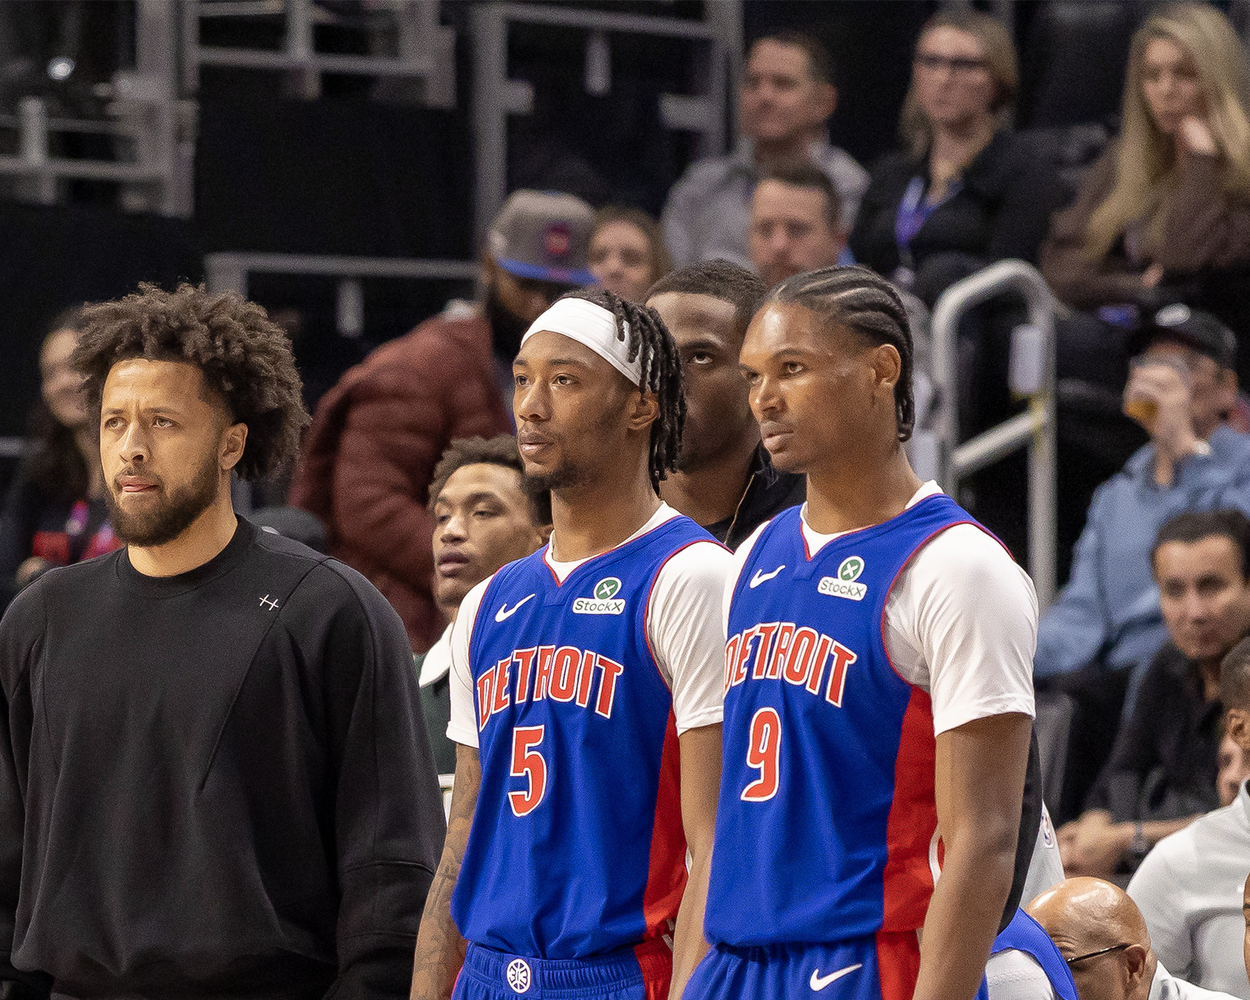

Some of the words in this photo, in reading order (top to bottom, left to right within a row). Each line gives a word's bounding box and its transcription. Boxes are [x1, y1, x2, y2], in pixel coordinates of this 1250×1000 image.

[575, 600, 622, 613] StockX
[821, 579, 865, 598] StockX
[477, 645, 624, 732] DETROIT
[723, 622, 858, 709] DETROIT
[508, 725, 547, 817] 5
[740, 707, 782, 802] 9
